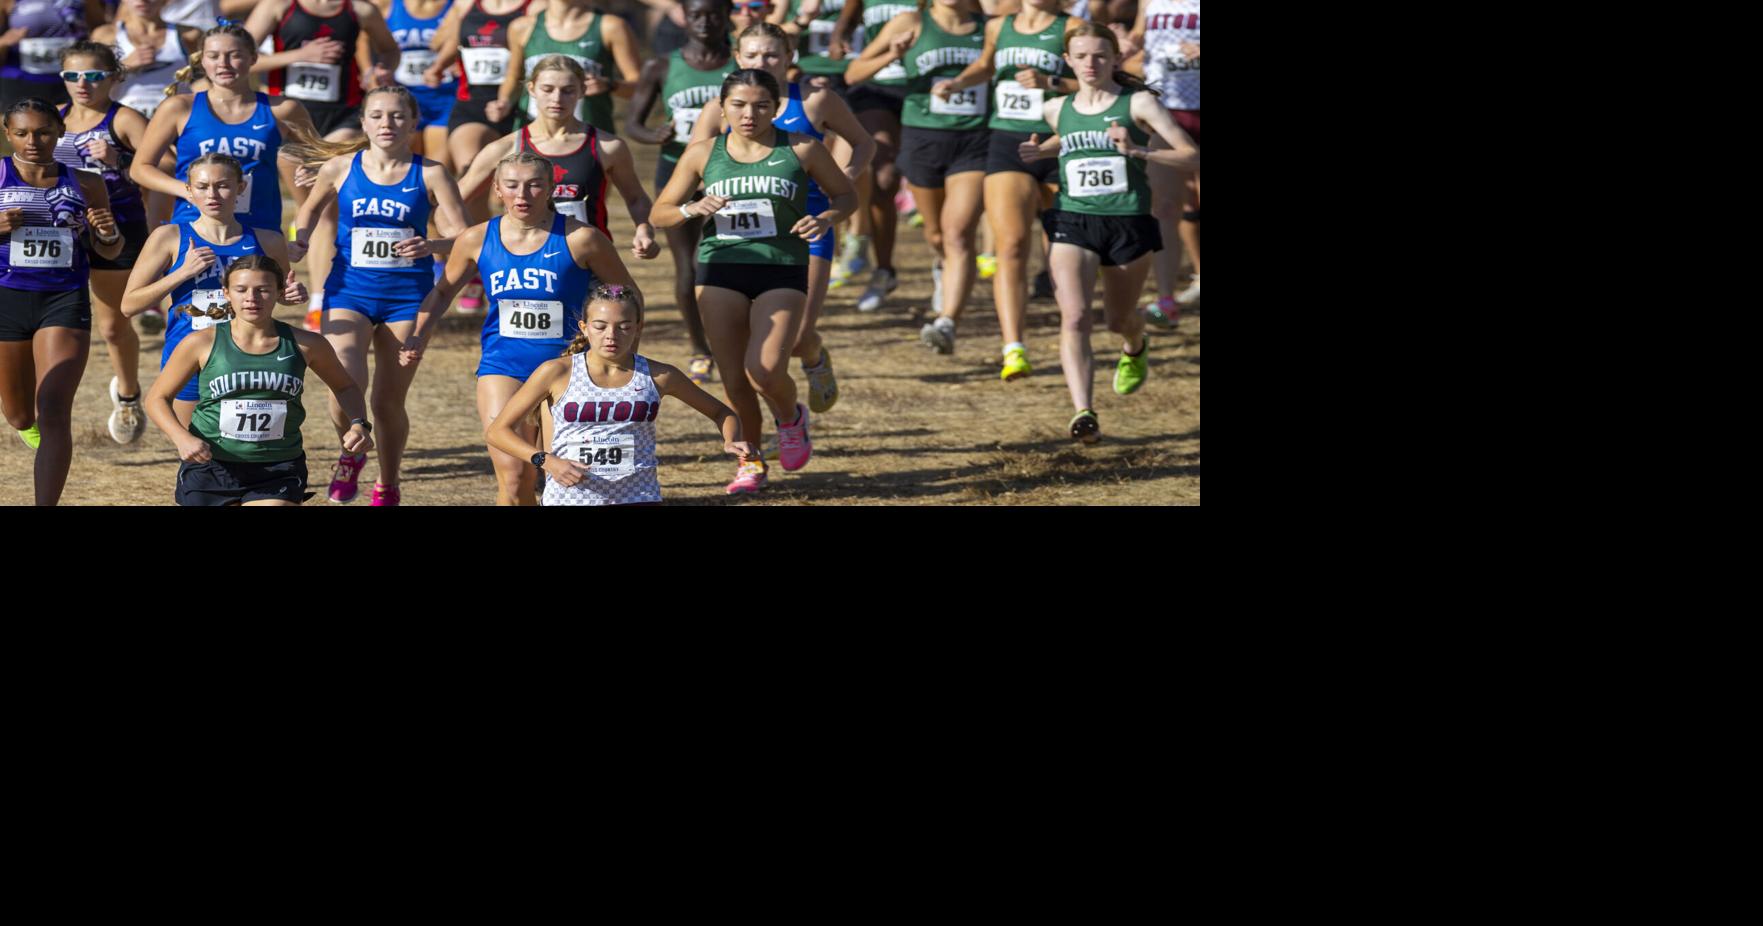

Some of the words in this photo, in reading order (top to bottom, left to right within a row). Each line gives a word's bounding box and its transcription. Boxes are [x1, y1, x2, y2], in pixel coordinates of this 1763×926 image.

[391, 28, 437, 48] EAS
[296, 74, 329, 91] 479
[1002, 93, 1031, 110] 725
[199, 136, 266, 160] EAST
[1077, 169, 1113, 187] 736
[706, 176, 799, 200] SOUTHWEST
[352, 197, 411, 221] EAST
[727, 212, 760, 230] 741
[23, 240, 61, 257] 576
[490, 267, 557, 296] EAST
[510, 311, 551, 329] 408
[564, 400, 659, 422] GATORS
[235, 413, 271, 432] 712
[579, 446, 622, 466] 549
